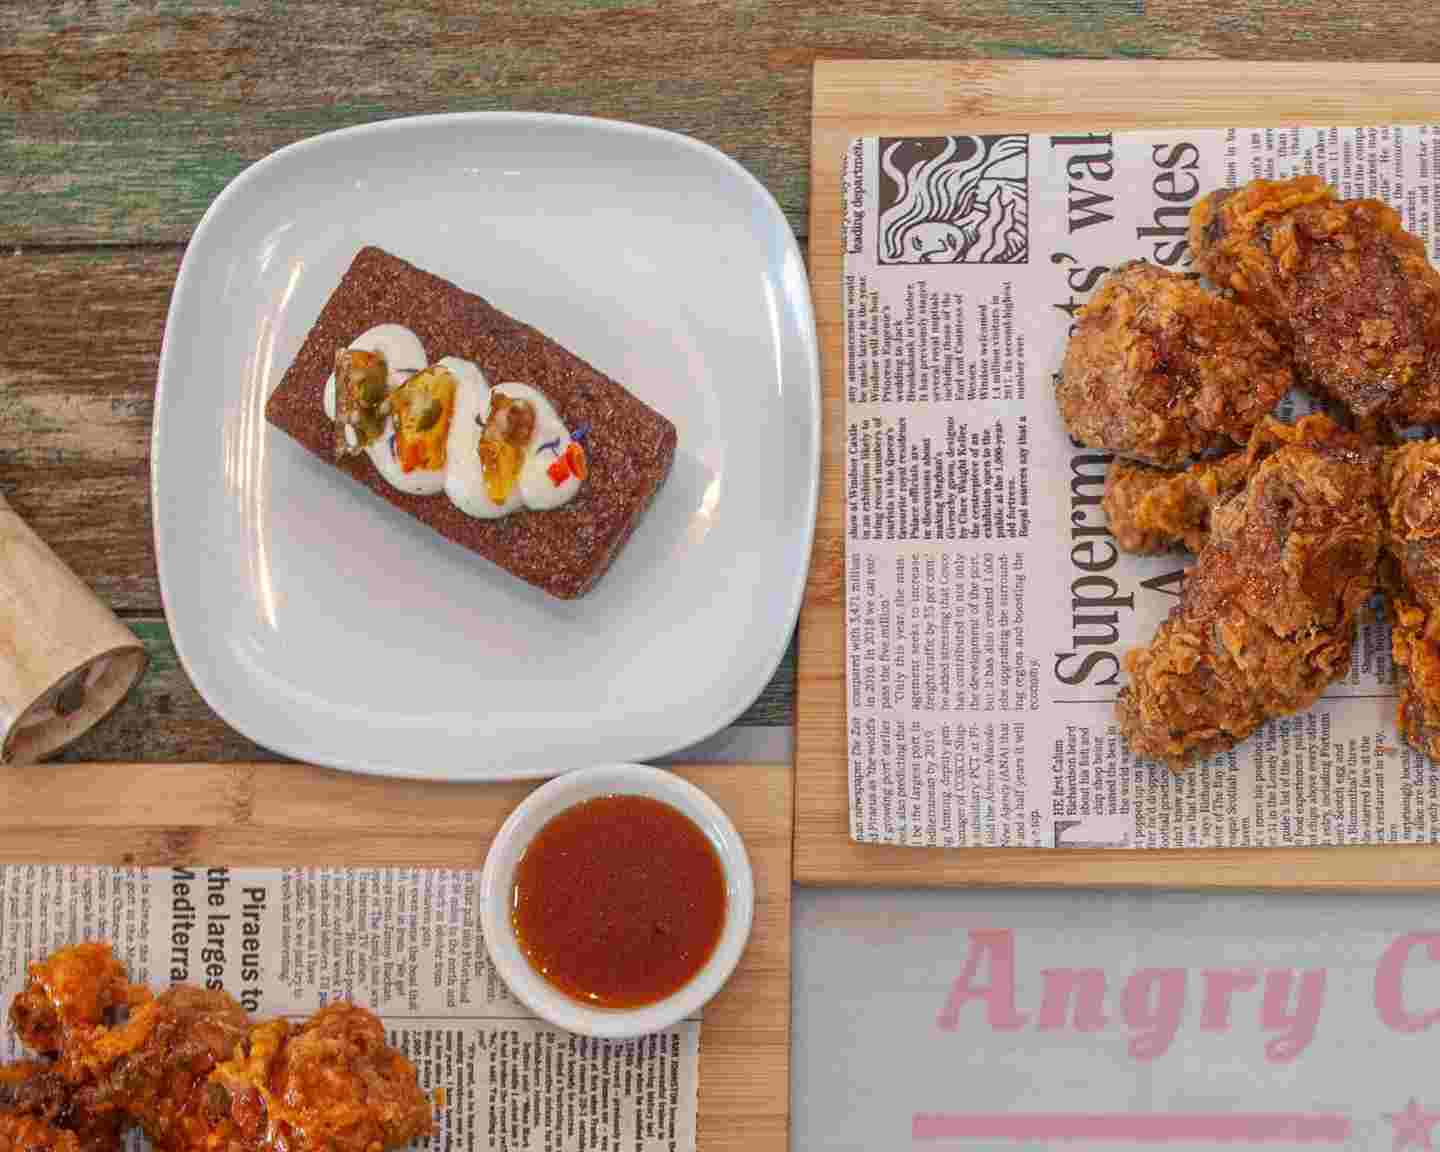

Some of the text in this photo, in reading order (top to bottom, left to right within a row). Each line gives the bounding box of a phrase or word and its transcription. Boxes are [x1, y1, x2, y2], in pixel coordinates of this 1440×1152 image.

[1136, 142, 1199, 268] shes
[1050, 251, 1133, 686] Supermts'
[170, 865, 195, 988] editerra
[201, 867, 230, 991] the larges
[240, 887, 266, 1013] Piraeus to
[936, 927, 1327, 1062] Angry
